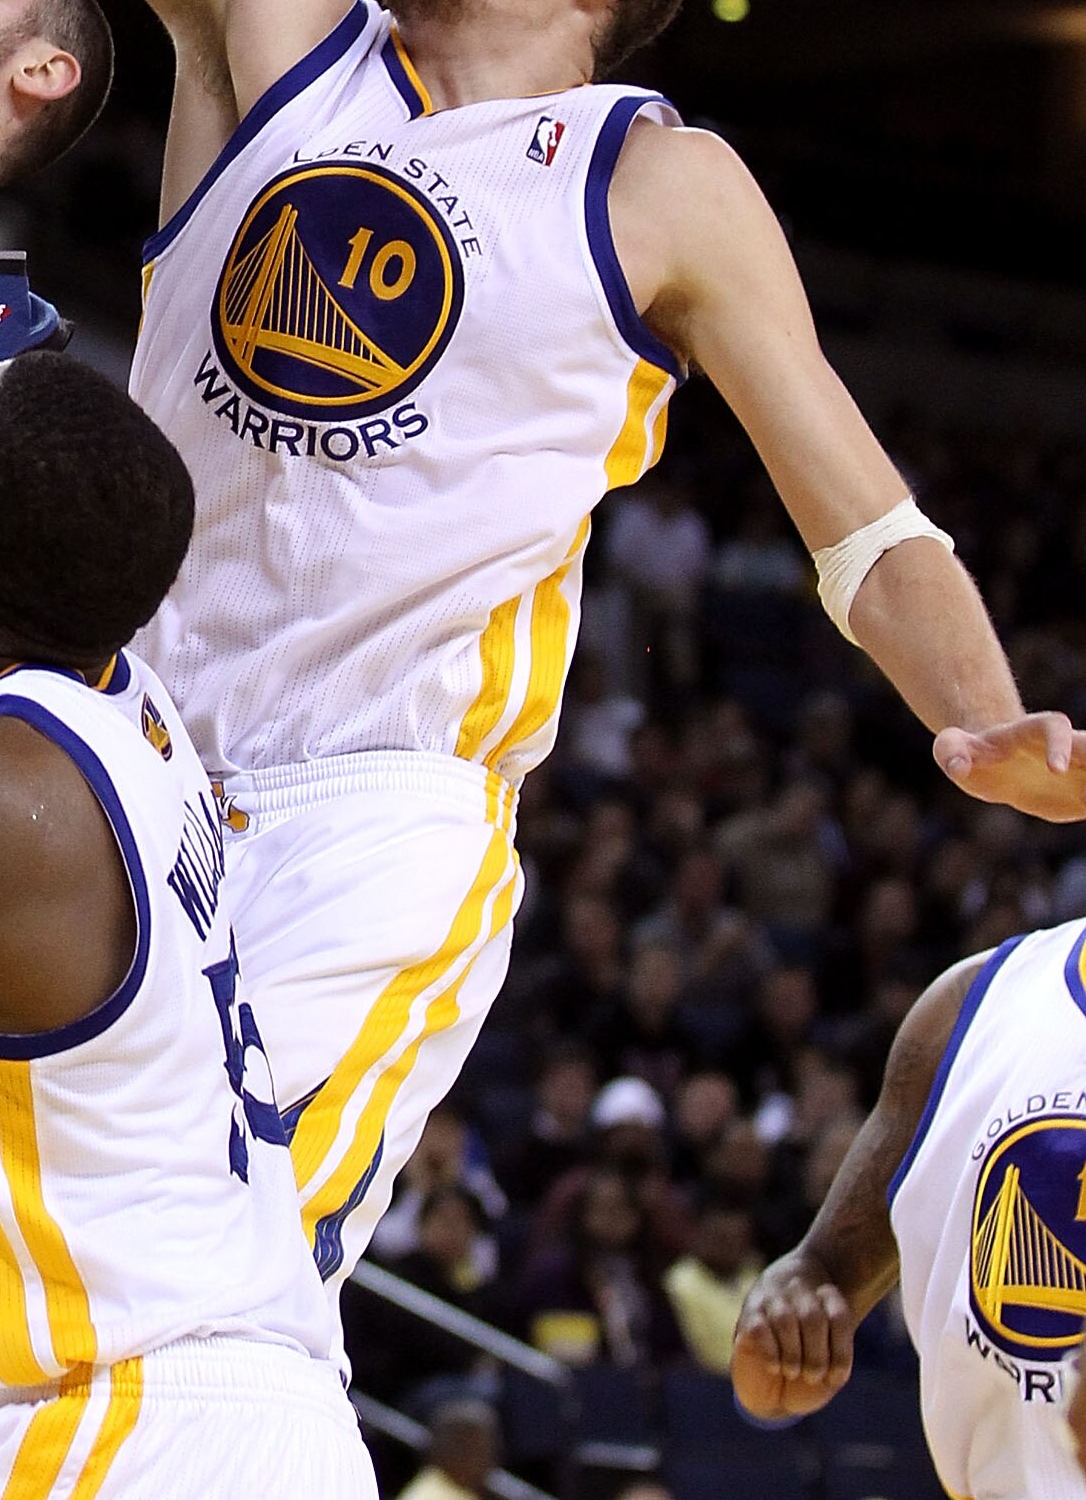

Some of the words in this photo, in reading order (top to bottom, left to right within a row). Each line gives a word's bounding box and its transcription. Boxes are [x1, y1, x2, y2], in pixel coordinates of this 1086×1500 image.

[403, 158, 483, 259] STATE
[338, 227, 416, 300] 10
[193, 350, 429, 462] WARRIORS
